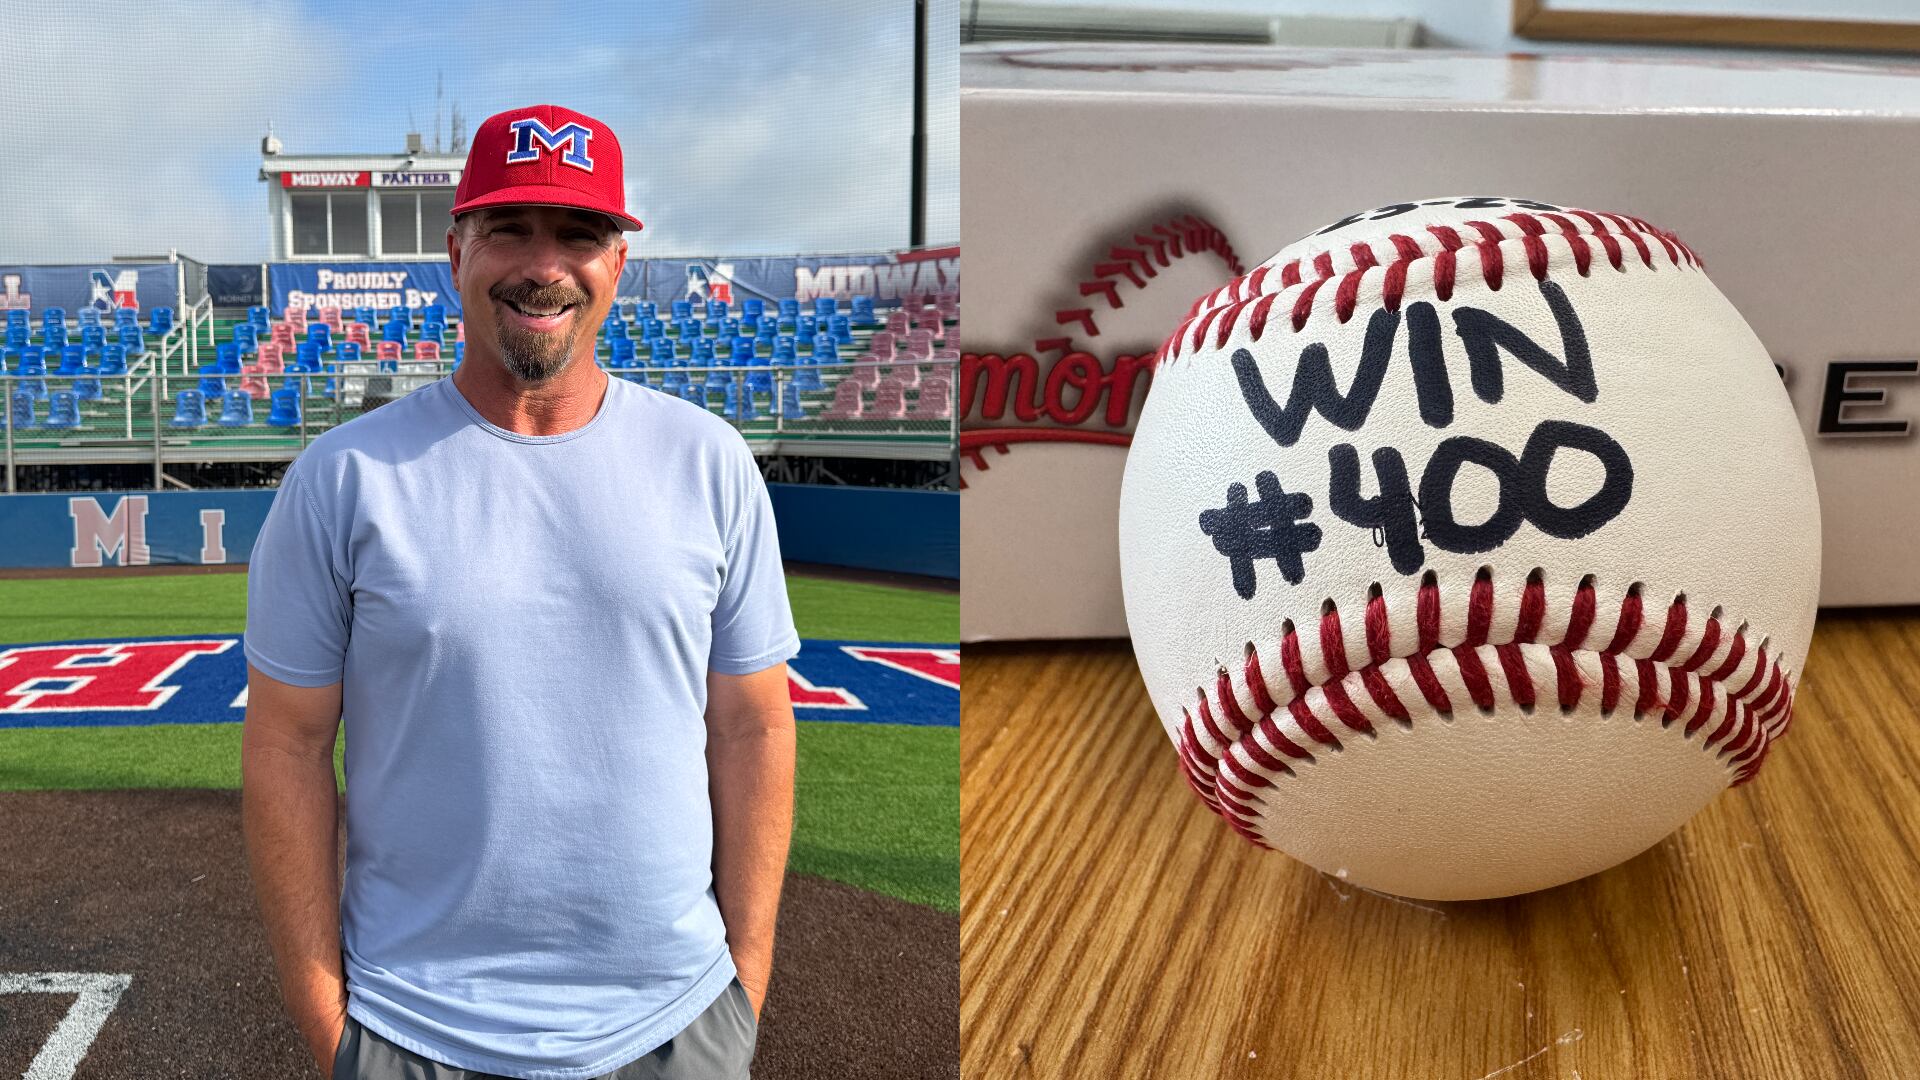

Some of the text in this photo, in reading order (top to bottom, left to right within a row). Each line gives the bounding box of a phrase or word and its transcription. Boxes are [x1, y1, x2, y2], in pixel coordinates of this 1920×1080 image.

[506, 117, 594, 175] M
[290, 172, 451, 187] MIDWAY PANTHER
[288, 289, 438, 311] SPONSORED BY
[317, 269, 407, 290] PROUDLY
[795, 257, 960, 303] MIDWAY
[1230, 281, 1599, 447] WIN
[1774, 362, 1918, 434] E
[1200, 419, 1635, 599] #400
